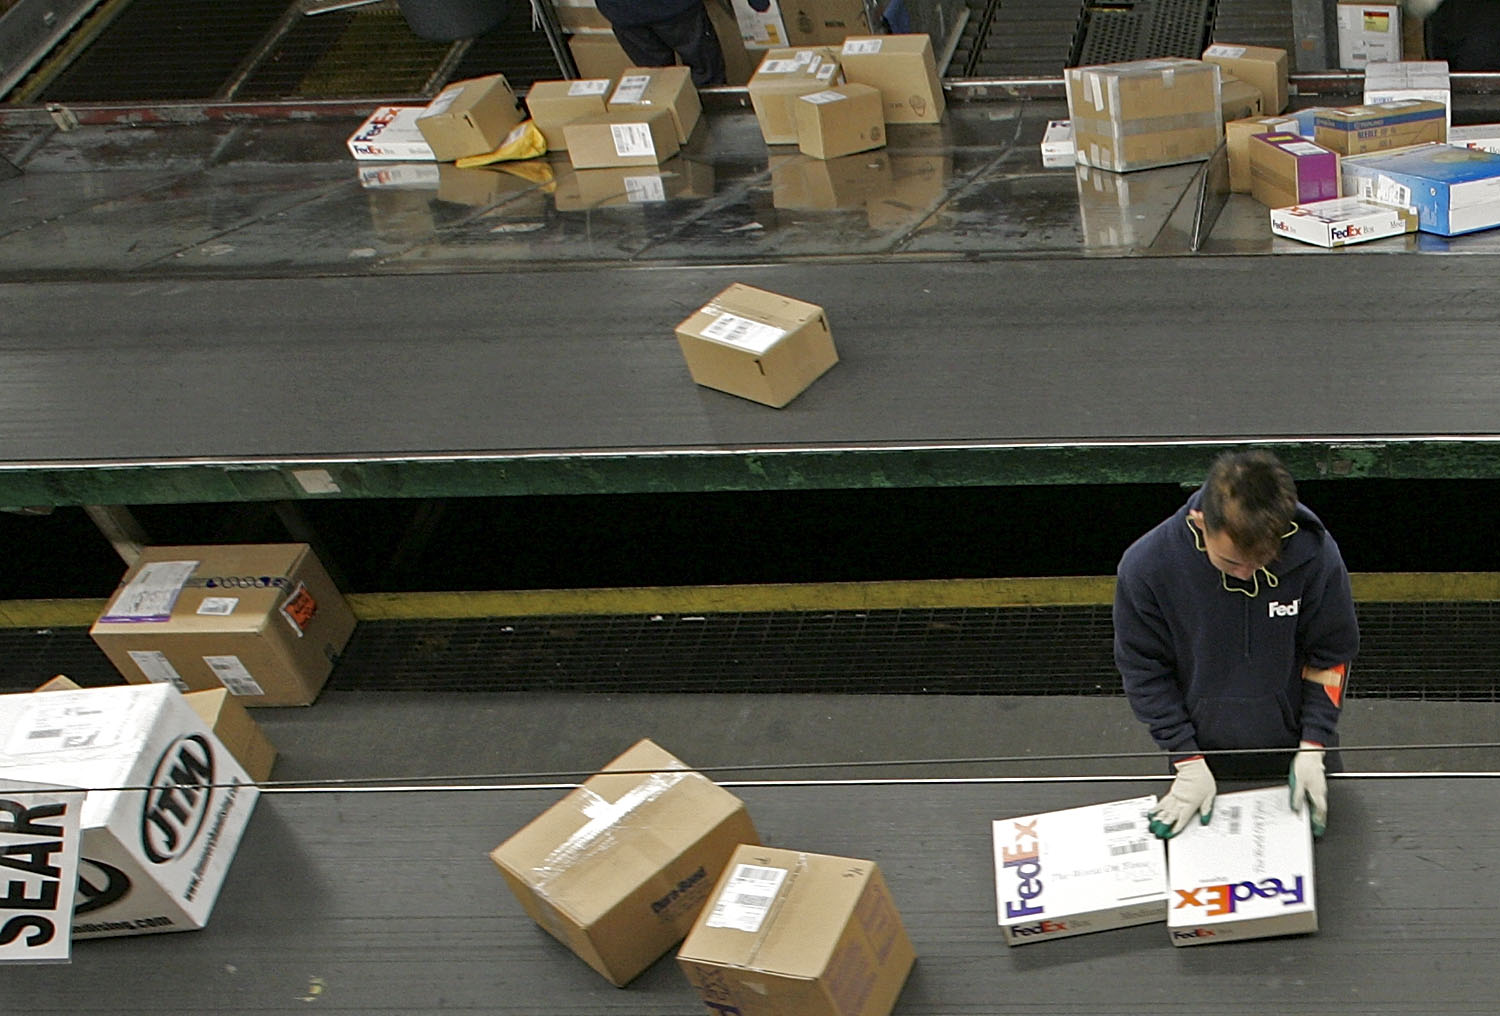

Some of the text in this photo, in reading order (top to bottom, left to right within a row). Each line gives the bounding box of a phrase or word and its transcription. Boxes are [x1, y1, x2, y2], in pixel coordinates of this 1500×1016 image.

[1331, 225, 1362, 240] FedEx
[1269, 601, 1299, 617] Fed
[1002, 819, 1045, 919] FedEx
[1175, 876, 1304, 916] FedEx
[1011, 920, 1066, 939] FedEx
[1174, 928, 1215, 940] FedEx
